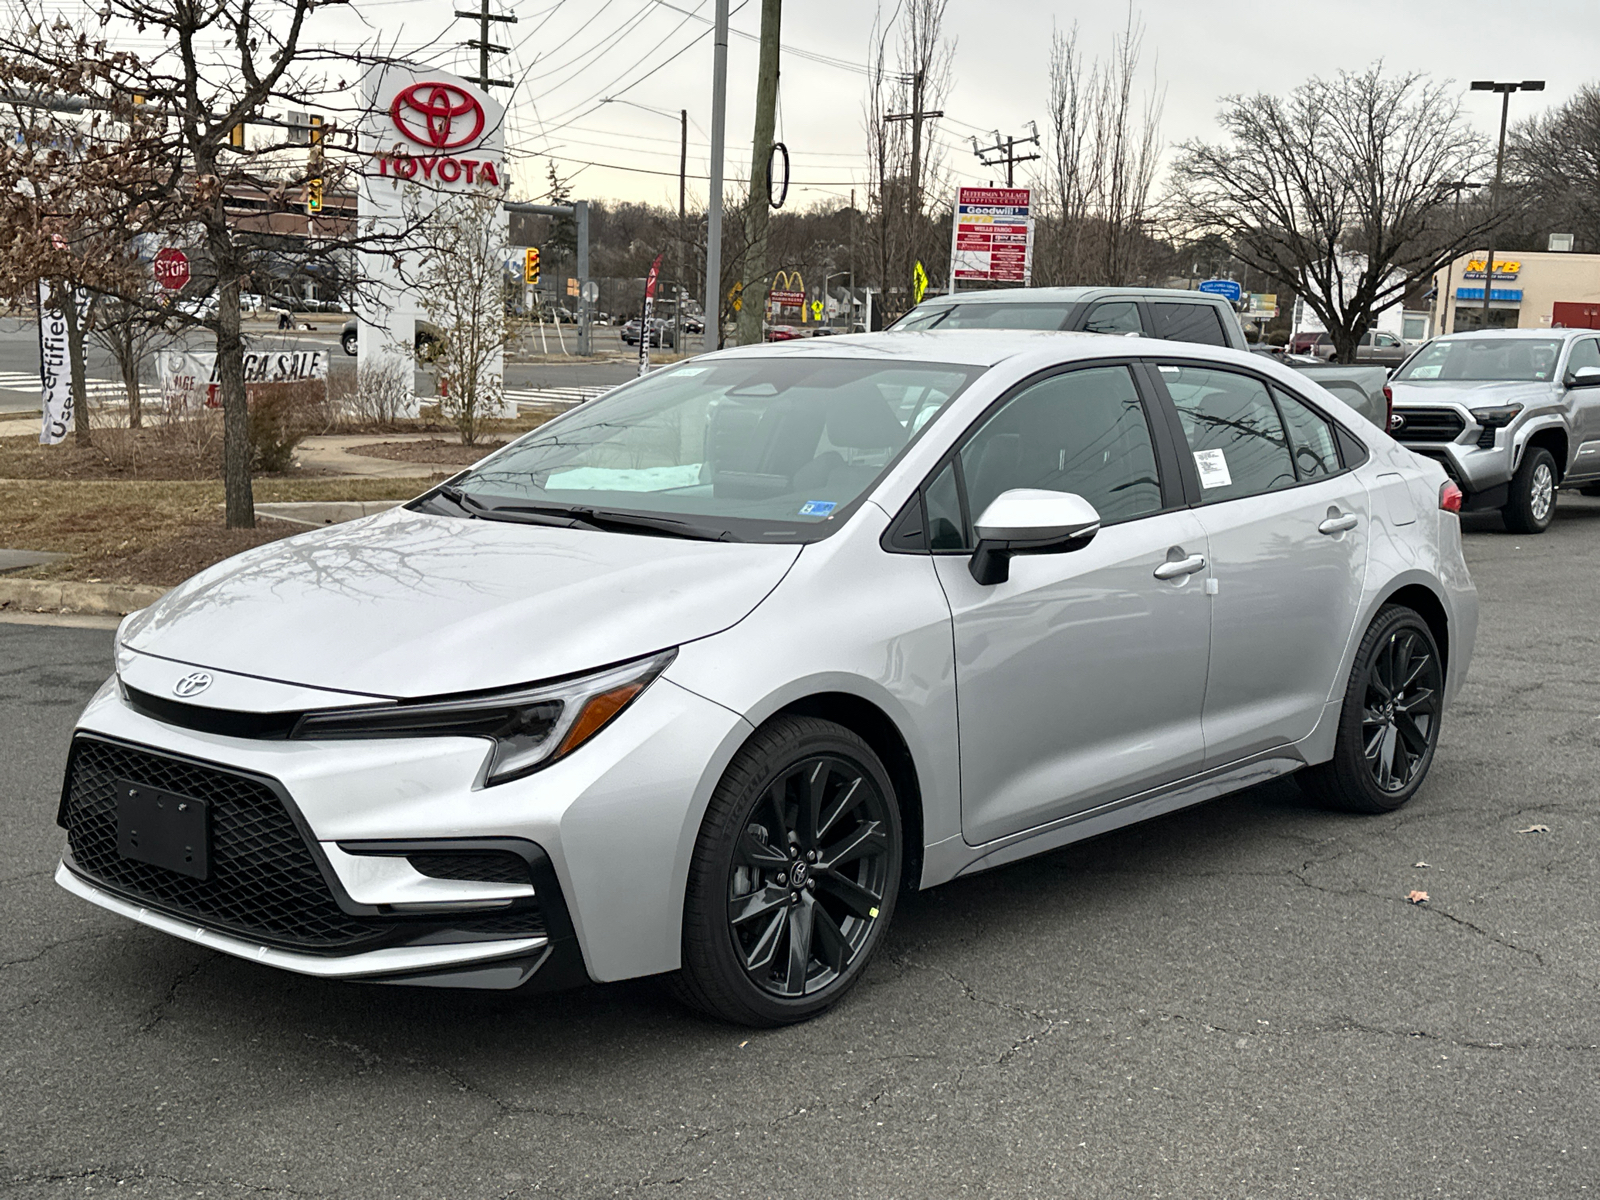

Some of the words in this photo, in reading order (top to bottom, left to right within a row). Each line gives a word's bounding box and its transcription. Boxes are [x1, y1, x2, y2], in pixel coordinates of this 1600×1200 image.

[378, 154, 499, 186] TOYOTA
[962, 190, 997, 198] JEFFERSON
[999, 190, 1028, 199] VILLAGE
[967, 206, 1013, 215] Goodwill
[961, 215, 993, 223] NTB
[156, 259, 188, 277] STOP
[1466, 259, 1521, 273] NTB
[273, 352, 320, 381] SALE
